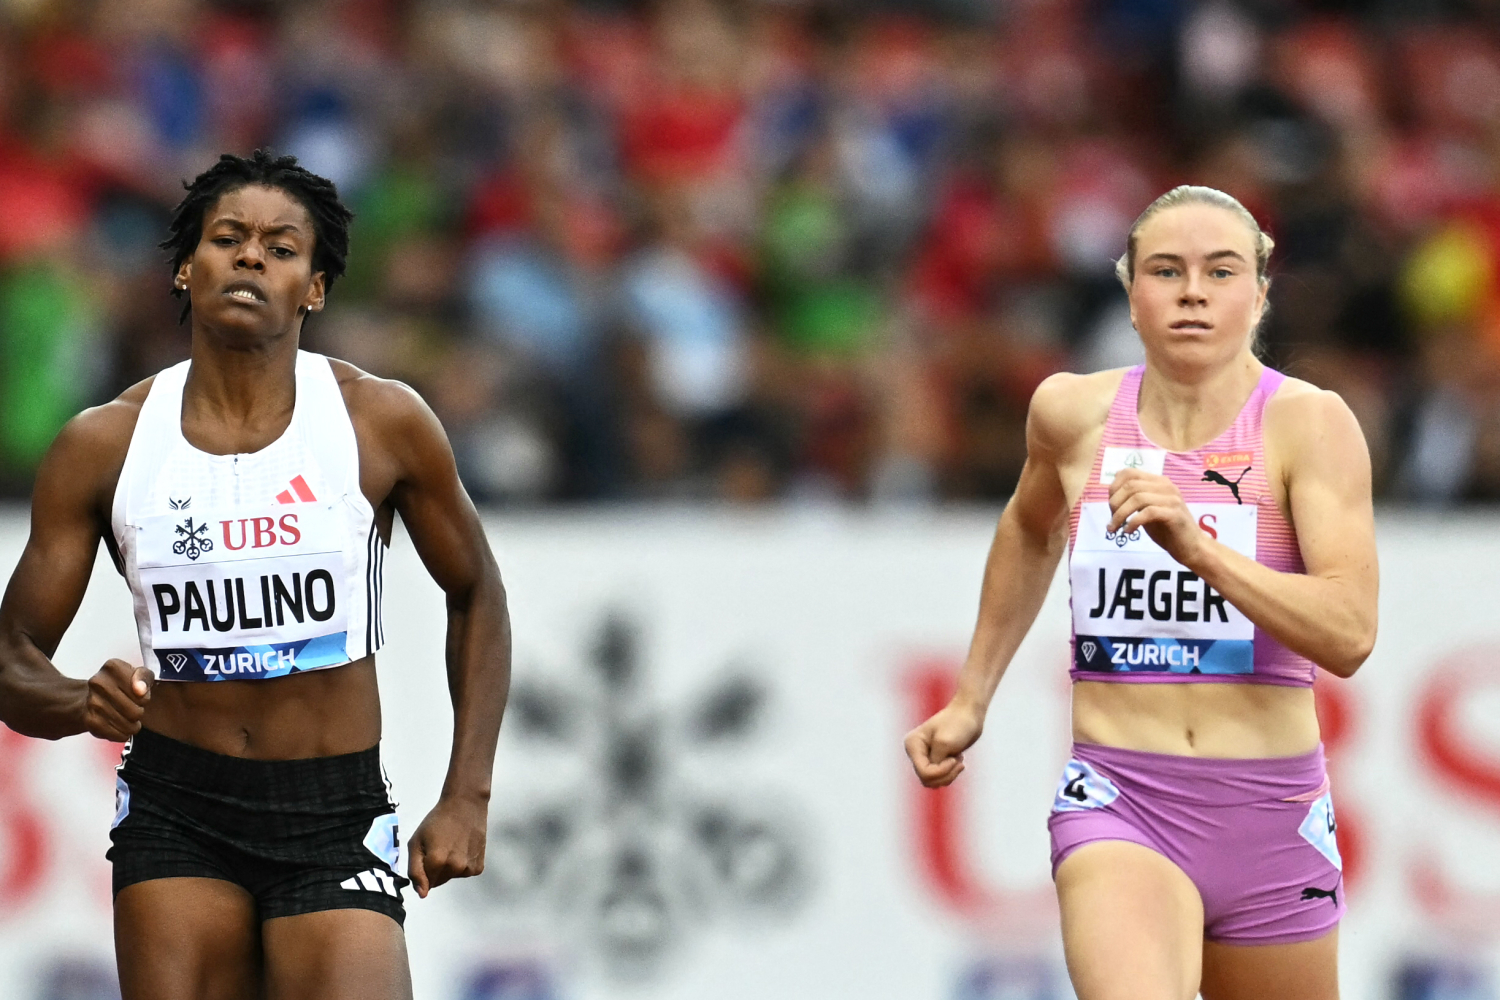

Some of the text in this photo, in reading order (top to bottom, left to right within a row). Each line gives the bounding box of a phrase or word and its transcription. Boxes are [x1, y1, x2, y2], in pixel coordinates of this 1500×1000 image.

[219, 513, 302, 551] UBS
[152, 568, 336, 632] PAULINO
[1089, 567, 1230, 623] JÆGER
[203, 648, 296, 675] ZURICH
[1110, 642, 1200, 667] ZURICH
[1063, 773, 1088, 802] 4
